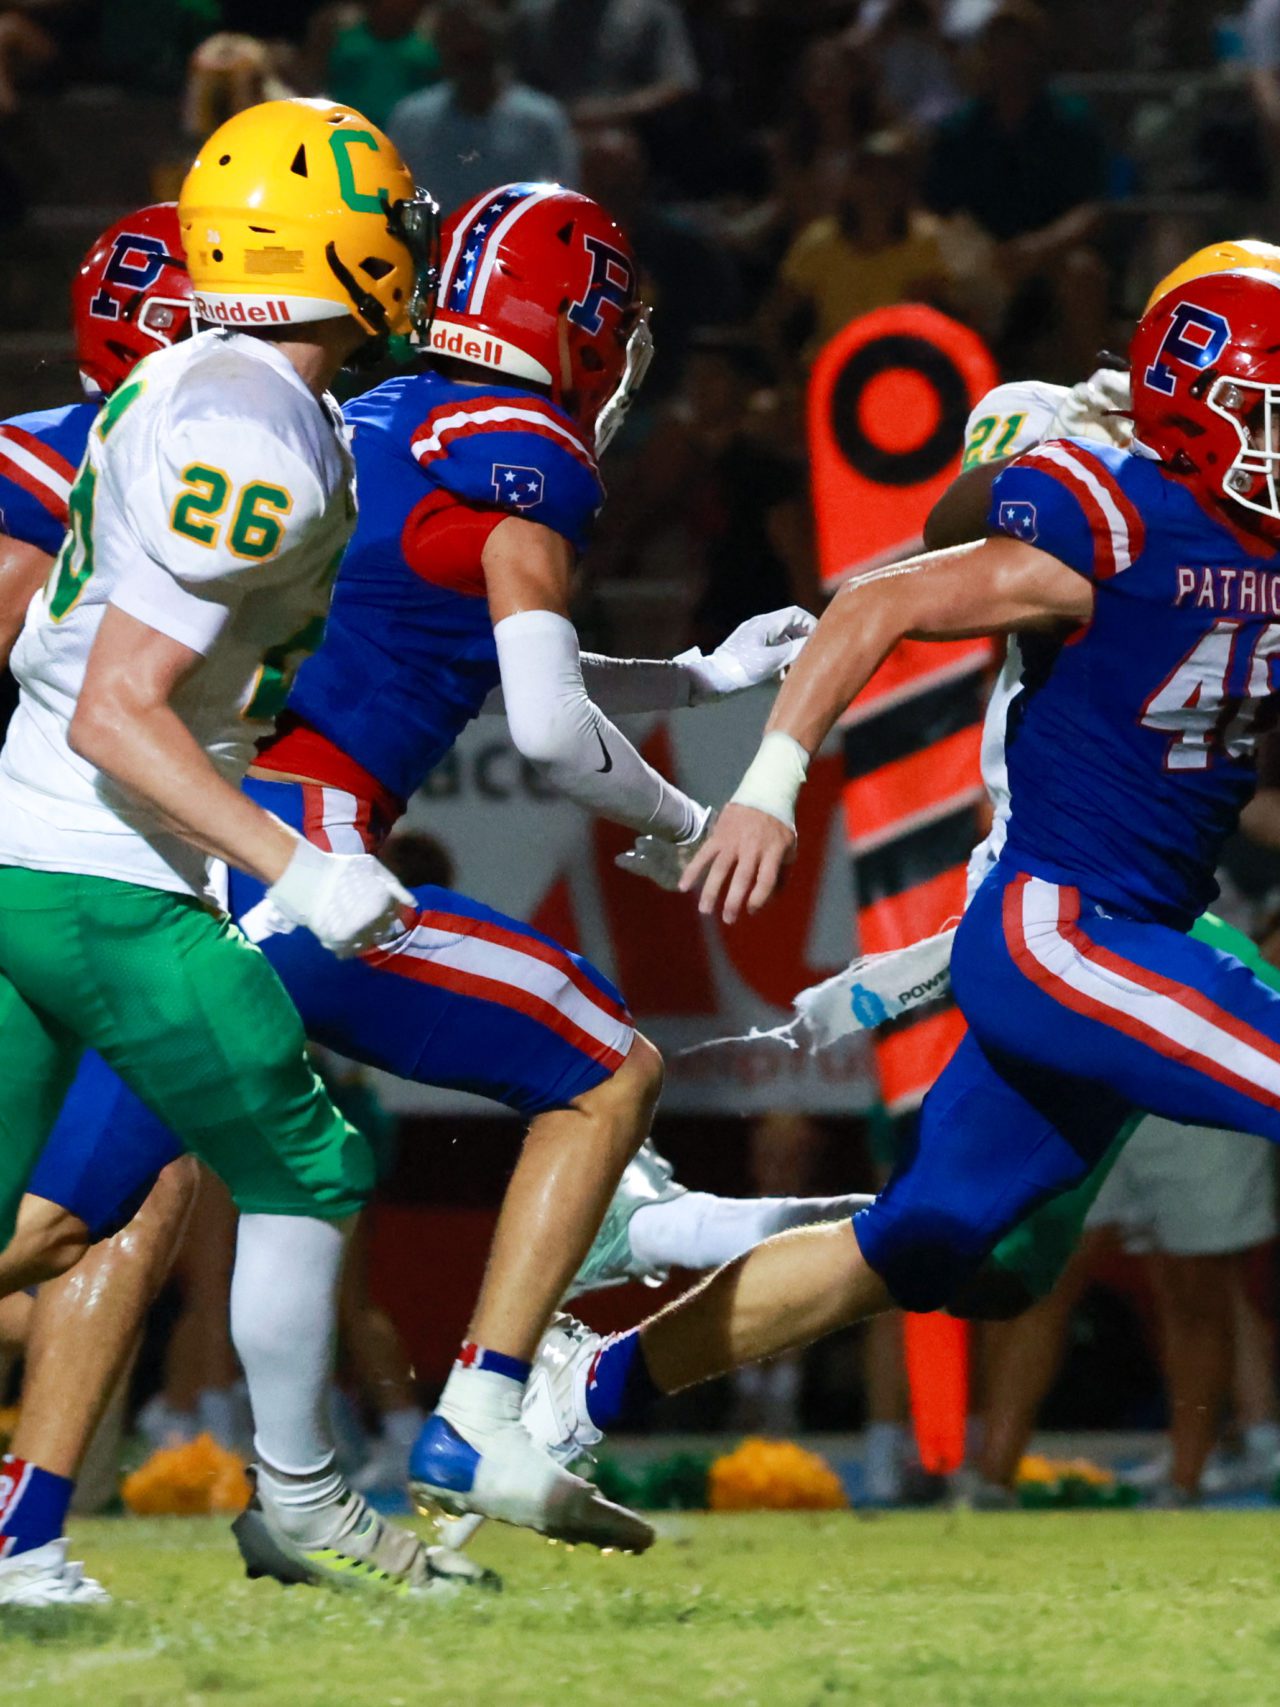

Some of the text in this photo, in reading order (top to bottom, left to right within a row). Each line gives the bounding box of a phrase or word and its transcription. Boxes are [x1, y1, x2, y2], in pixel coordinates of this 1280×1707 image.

[328, 129, 389, 214] C
[90, 231, 170, 321] P
[195, 296, 292, 322] Riddell
[567, 233, 636, 336] P
[432, 328, 503, 366] ddell
[1143, 301, 1232, 397] P
[963, 411, 1029, 472] 21
[169, 461, 294, 563] 26
